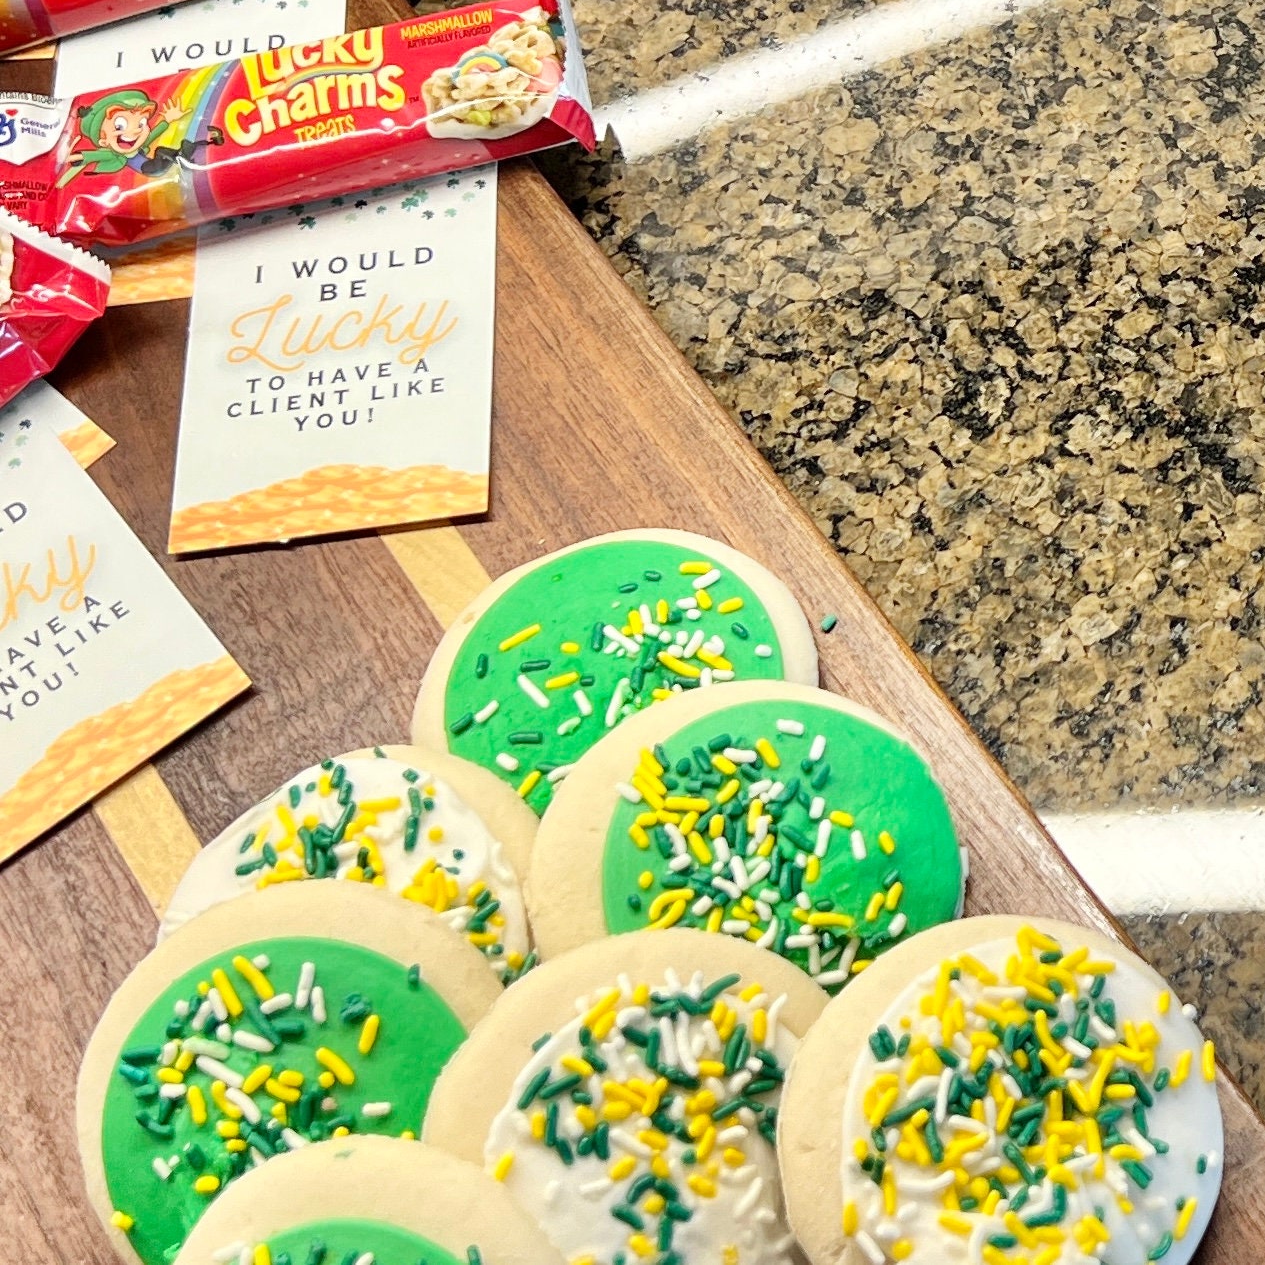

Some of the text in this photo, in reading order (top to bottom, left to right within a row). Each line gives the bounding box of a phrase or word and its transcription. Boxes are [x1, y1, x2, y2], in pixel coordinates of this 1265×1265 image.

[401, 9, 493, 40] MARSHMALLOW
[115, 34, 285, 68] I WOULD
[240, 25, 384, 101] Lucky
[224, 64, 405, 147] Charms
[256, 246, 434, 283] I WOULD
[319, 279, 367, 302] BE
[226, 293, 459, 372] Lucky
[246, 357, 430, 394] TO HAVE A
[226, 377, 446, 418] CLIENT LIKE
[294, 407, 375, 432] YOU!
[0, 595, 101, 671] AVE A
[54, 600, 130, 657] LIKE
[0, 662, 79, 722] YOU!
